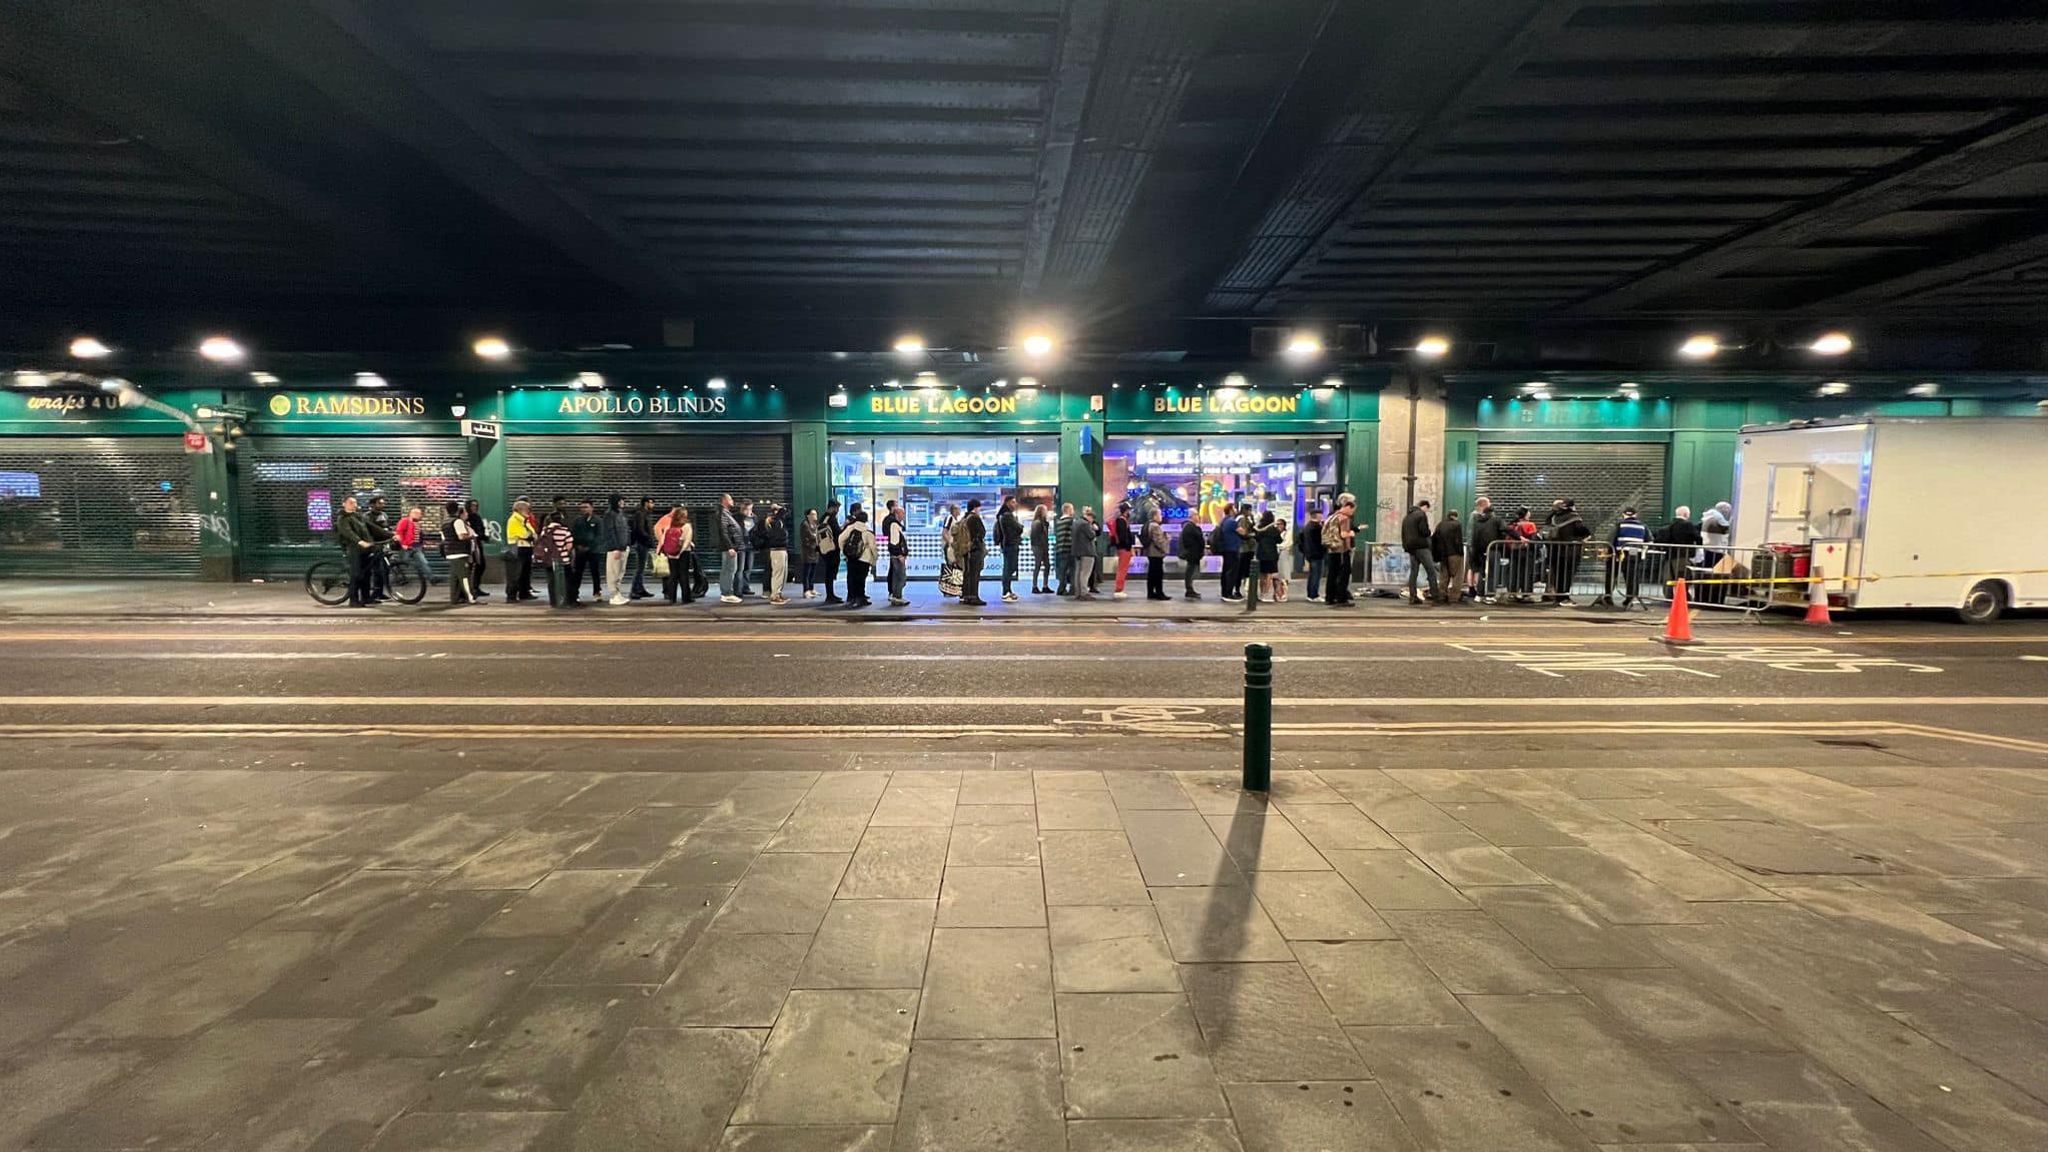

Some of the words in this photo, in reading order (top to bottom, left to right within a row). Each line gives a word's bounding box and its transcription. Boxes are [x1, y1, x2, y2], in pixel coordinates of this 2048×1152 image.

[27, 395, 87, 415] wraps
[91, 397, 101, 409] 4
[106, 397, 116, 409] U
[296, 397, 425, 414] RAMSDENS
[558, 396, 643, 413] APOLLO
[650, 396, 726, 413] BLINDS
[871, 397, 920, 413] BLUE
[928, 397, 1016, 413] LAGOON
[1154, 397, 1202, 413] BLUE
[1210, 397, 1297, 413] LAGOON
[885, 451, 928, 466] BLUE
[934, 451, 1010, 466] LAGOON
[1136, 450, 1181, 464] BLUE
[1445, 643, 1722, 678] LANE
[1677, 645, 1944, 673] BUS
